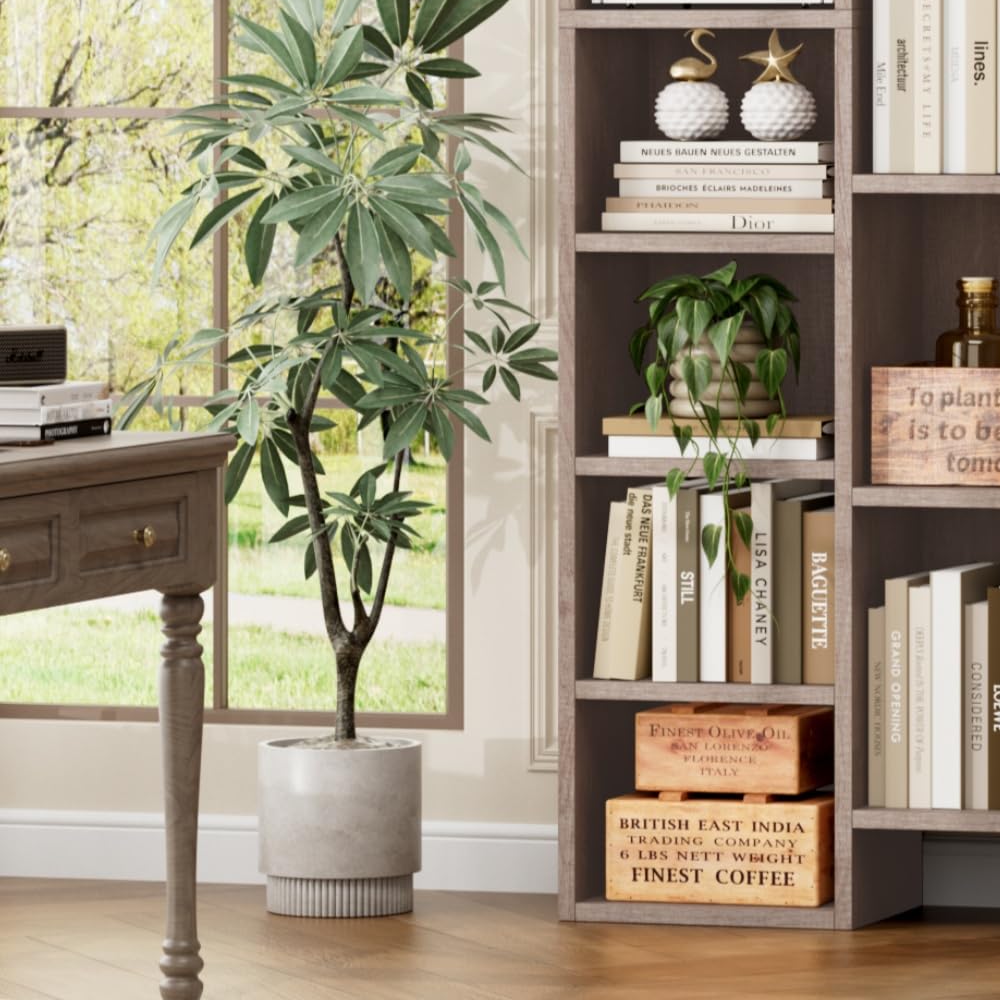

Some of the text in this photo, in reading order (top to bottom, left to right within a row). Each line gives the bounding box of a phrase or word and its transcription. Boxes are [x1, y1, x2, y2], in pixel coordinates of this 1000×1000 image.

[974, 41, 989, 86] lines.
[877, 62, 887, 107] Mile End
[923, 73, 931, 95] MY
[923, 104, 931, 138] LIFE
[641, 148, 796, 157] NEUES BAUEN NEUES GESTALTEN
[656, 182, 792, 192] BRIOCHES ÉCLAIRS MADELEINES
[731, 215, 775, 230] Dior
[908, 386, 934, 408] To
[940, 386, 1000, 409] plant
[909, 419, 929, 440] is
[939, 421, 966, 440] to
[622, 493, 637, 556] die neue stadt
[632, 494, 652, 603] DAS NEUE FRANKFURT
[681, 571, 694, 605] STILL
[755, 532, 767, 646] LISA CHANEY
[811, 552, 827, 649] BAGUETTE
[891, 631, 901, 744] GRAND OPENING
[971, 662, 982, 752] CONSIDERED
[649, 724, 791, 740] FINEST OLIVE OIL
[671, 742, 769, 751] SAN LORENZO
[683, 755, 756, 764] FLORENCE
[700, 768, 738, 776] ITALY
[620, 818, 805, 834] BRITISH EAST INDIA
[627, 835, 798, 848] TRADING COMPANY
[620, 850, 806, 864] 6 LBS NETT WEIGHT
[632, 867, 795, 887] FINEST COFFEE
